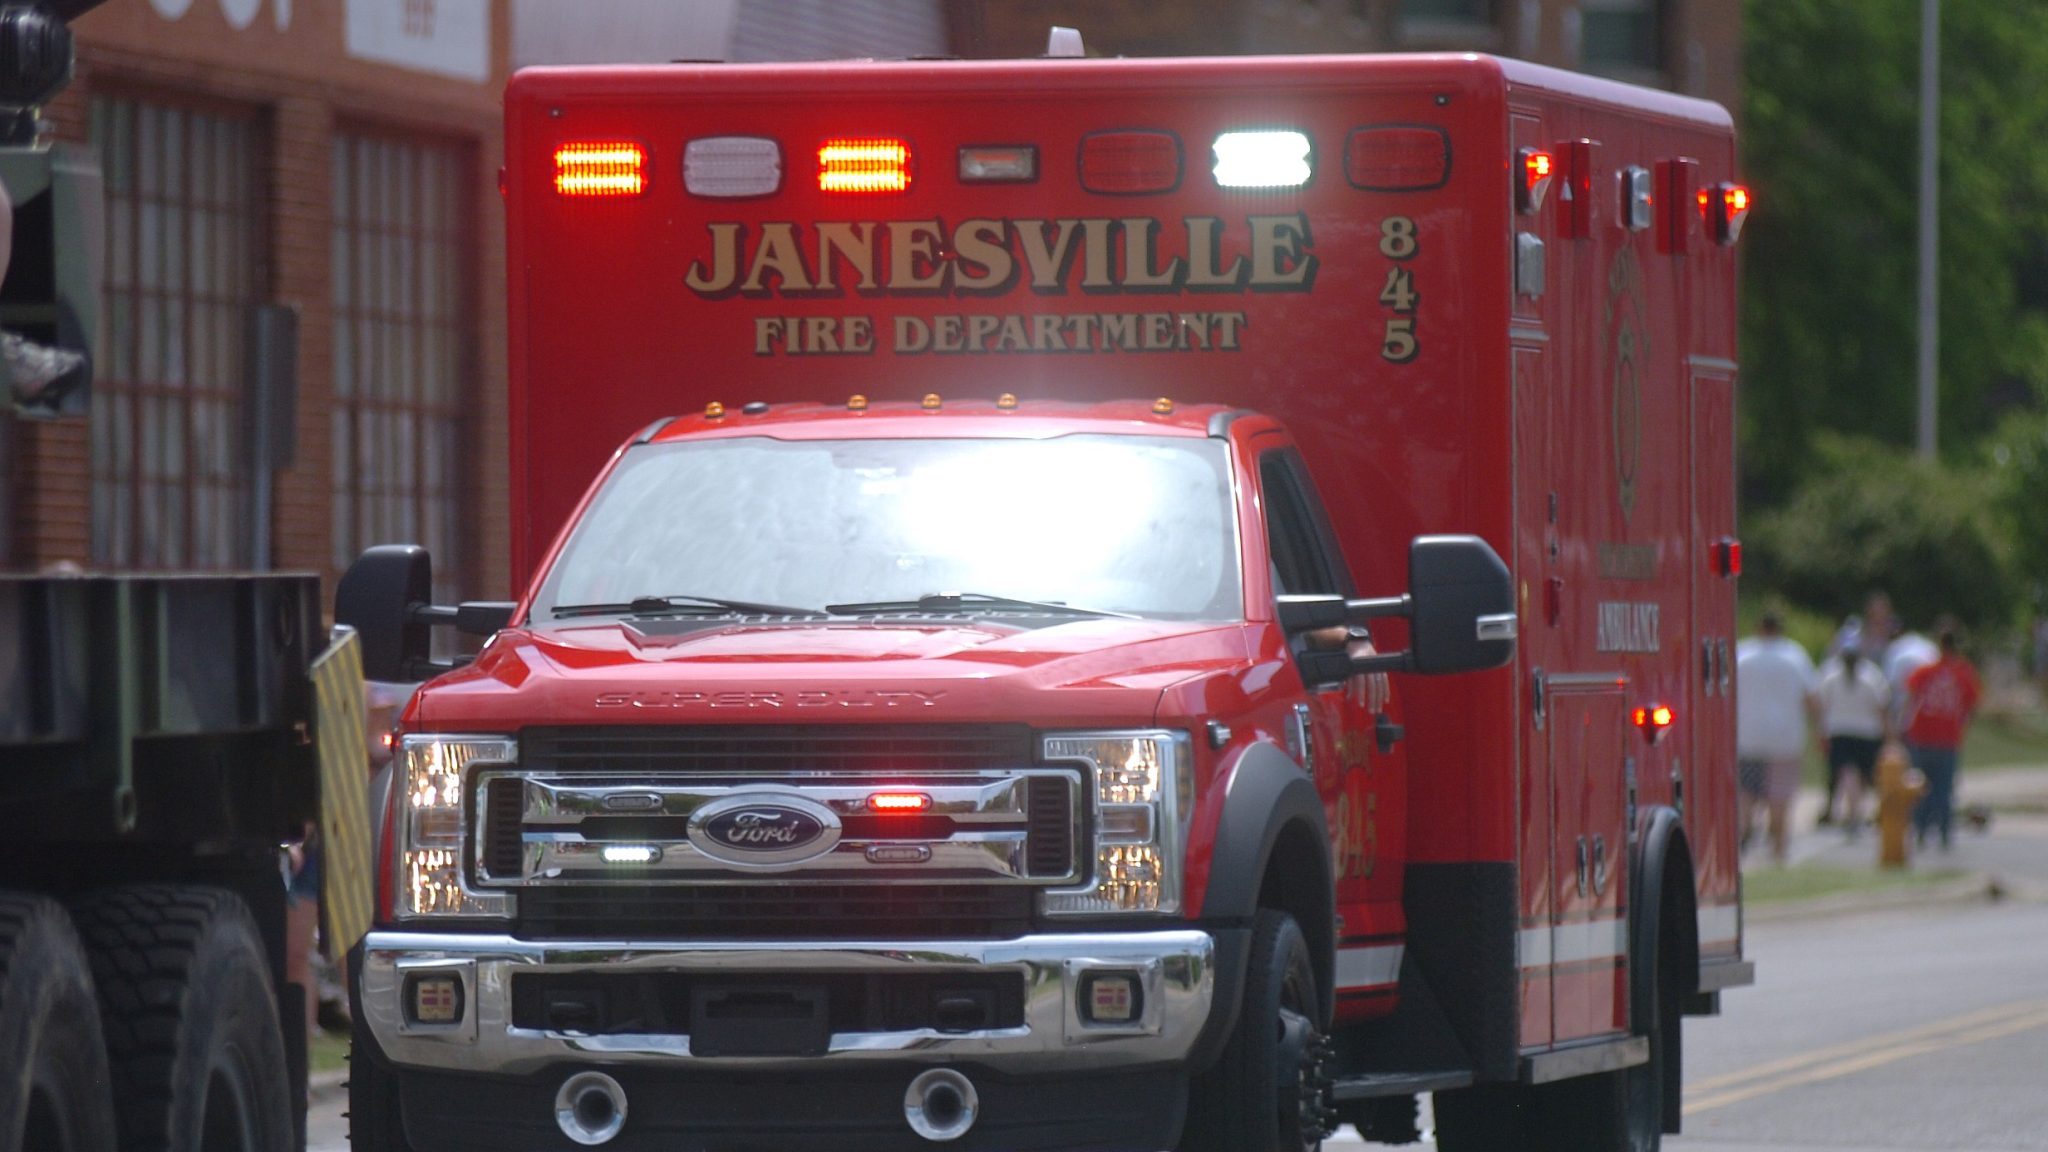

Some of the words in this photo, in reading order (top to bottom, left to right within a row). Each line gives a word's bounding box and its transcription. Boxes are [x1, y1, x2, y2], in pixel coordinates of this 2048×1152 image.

[685, 215, 1317, 296] JANESVILLE
[754, 316, 874, 355] FIRE
[895, 311, 1247, 354] DEPARTMENT
[1596, 602, 1660, 653] AMBULANCE
[595, 691, 785, 708] SUPER
[796, 690, 948, 707] DUTY
[726, 811, 799, 843] Ford
